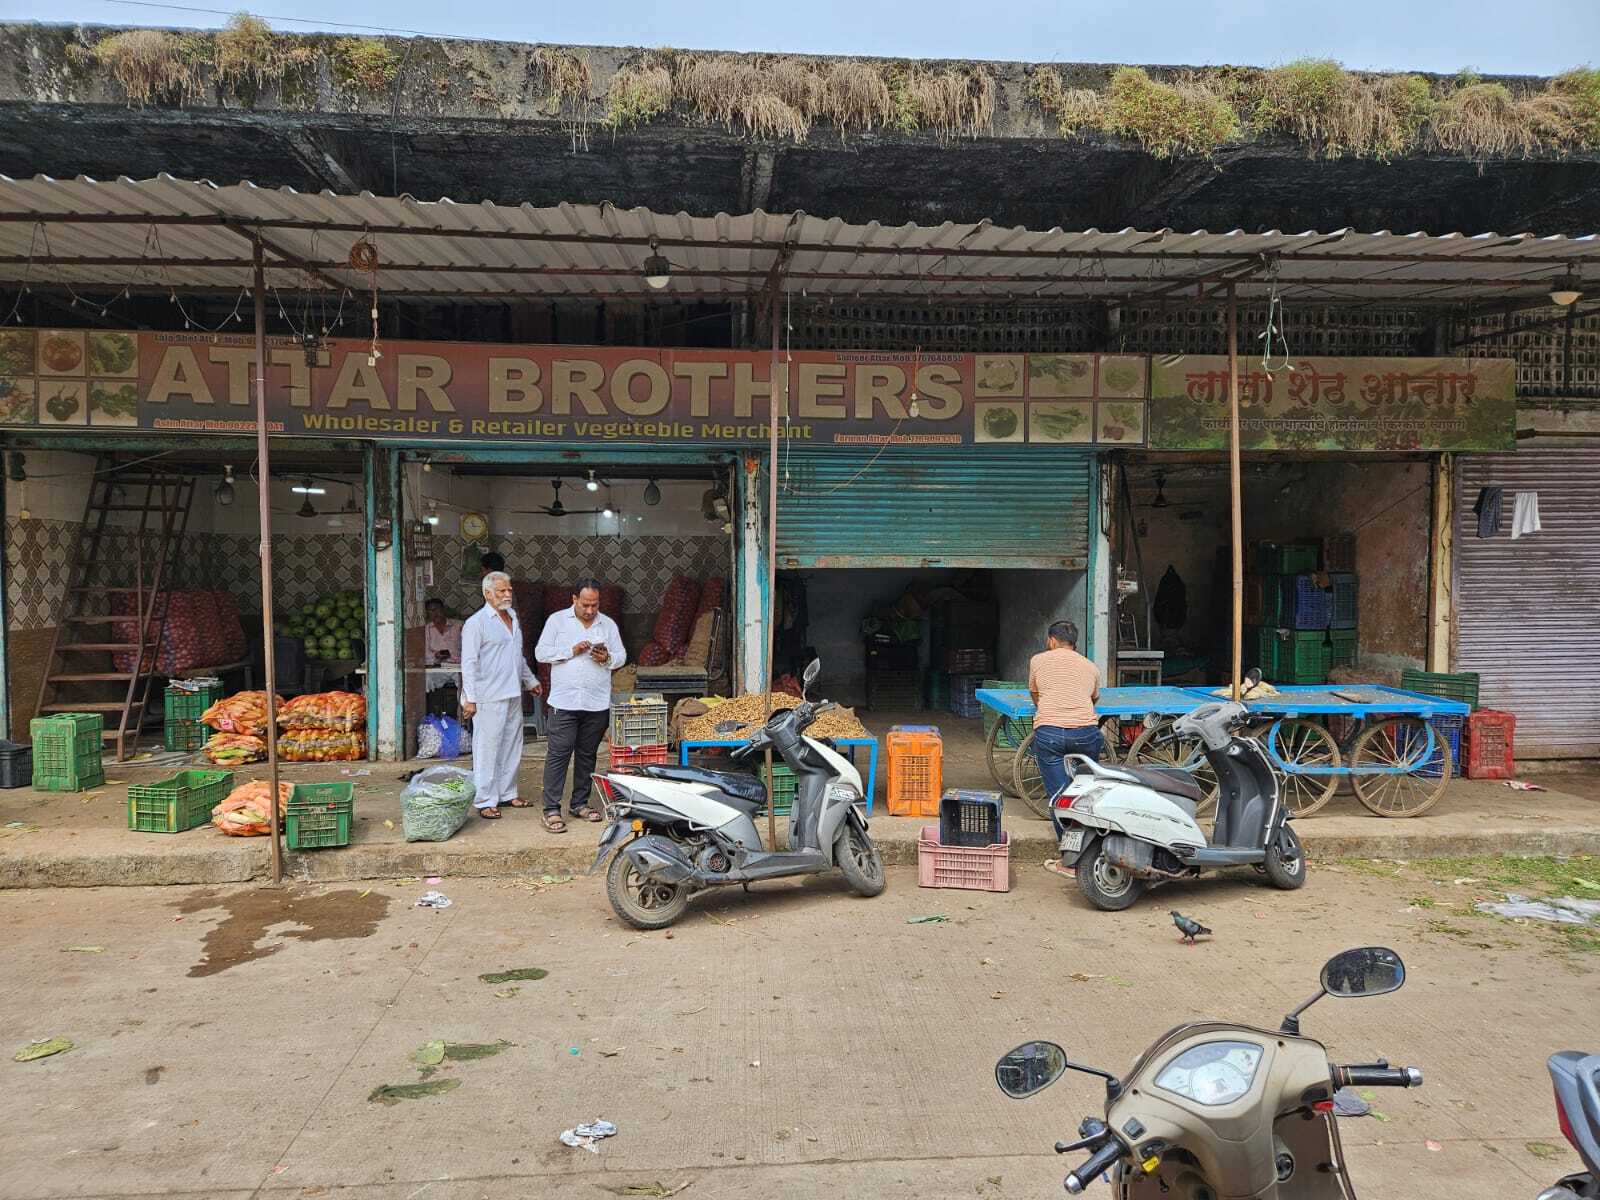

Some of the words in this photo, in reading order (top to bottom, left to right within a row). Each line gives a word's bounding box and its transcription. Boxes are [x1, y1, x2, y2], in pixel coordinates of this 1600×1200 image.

[146, 345, 456, 413] ATTAR
[488, 356, 965, 421] BROTHERS
[302, 414, 440, 434] Wholesaler
[449, 418, 463, 434] &
[472, 419, 567, 436] Retailer
[574, 421, 694, 439] Vegeteble
[702, 422, 812, 440] Merchant
